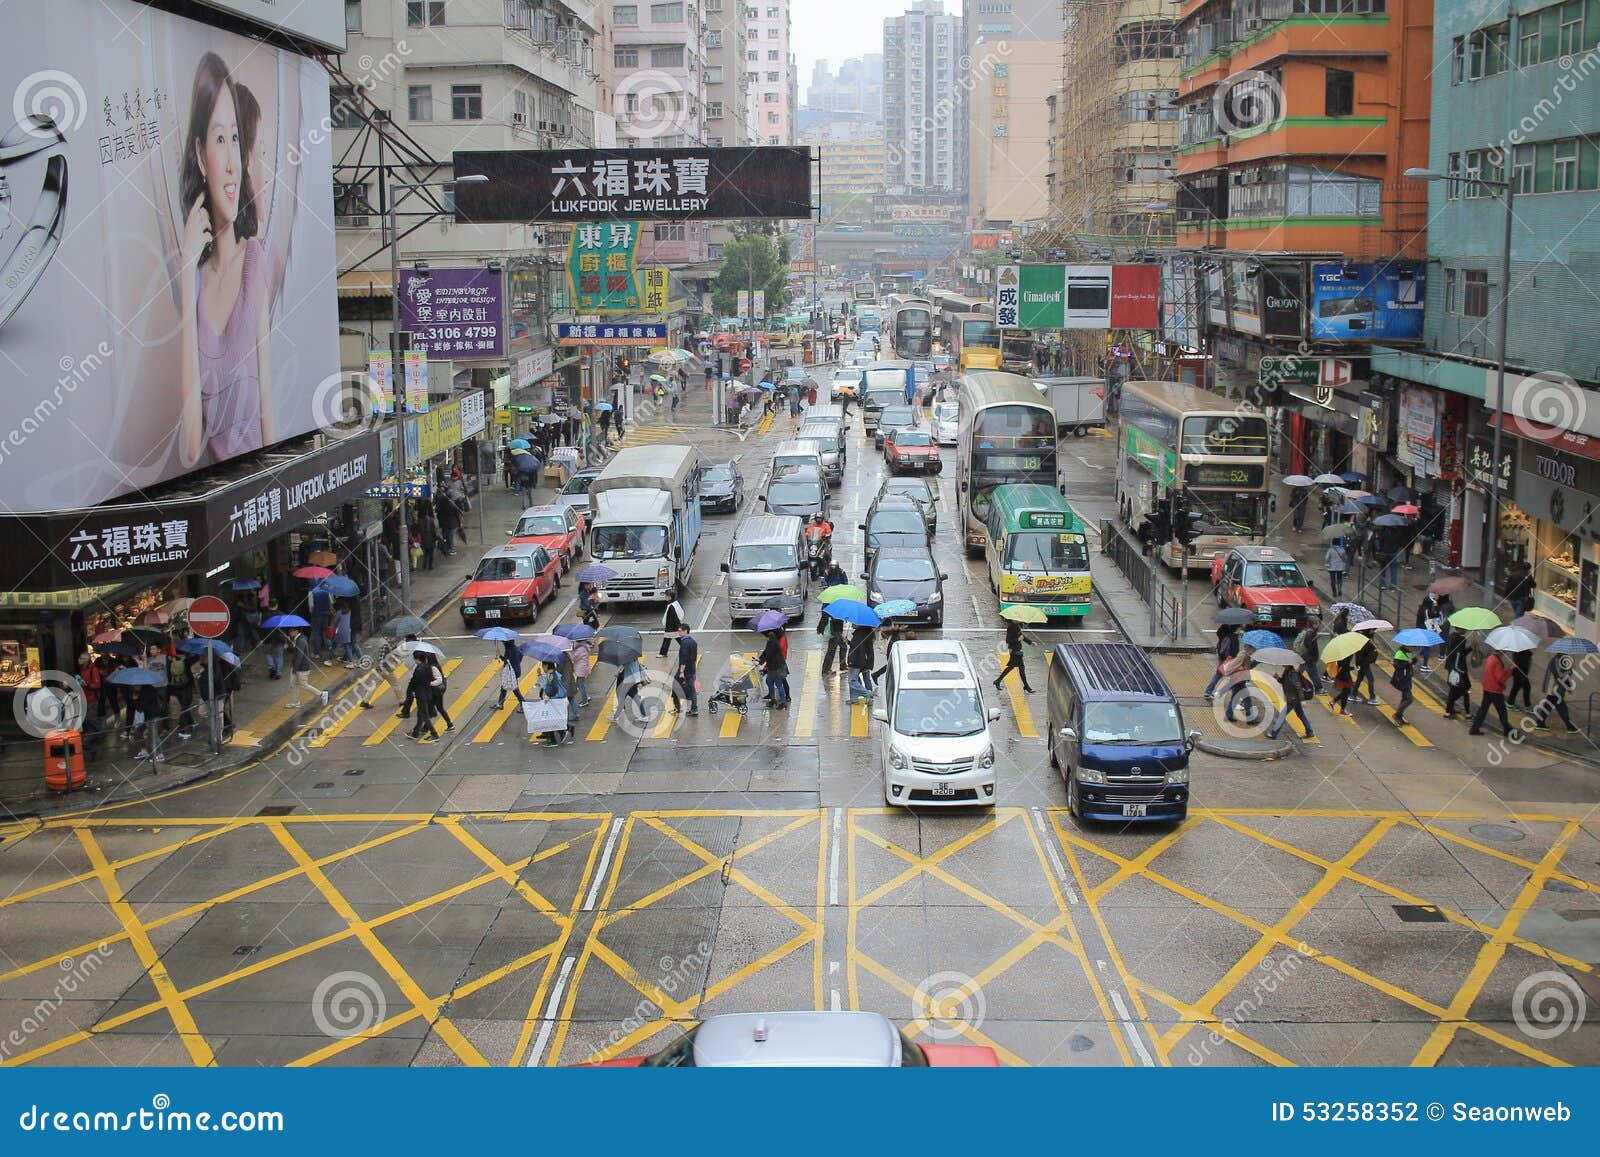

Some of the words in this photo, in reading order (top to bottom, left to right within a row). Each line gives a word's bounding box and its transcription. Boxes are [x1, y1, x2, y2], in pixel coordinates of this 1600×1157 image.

[551, 158, 710, 197] 六福珠寶
[551, 200, 618, 213] LUKFOOK
[623, 198, 710, 213] JEWELLERY
[577, 223, 632, 249] 東昇
[647, 270, 664, 308] 牆紙
[1320, 274, 1341, 282] TGC
[435, 287, 489, 296] EDINBURGH
[1023, 290, 1060, 303] Cimatech
[436, 308, 487, 321] 室內設計
[998, 288, 1017, 326] 成發
[429, 328, 461, 339] 3106
[465, 327, 497, 338] 4799
[286, 473, 326, 511] LUKFOOK
[326, 453, 368, 492] JEWELLERY
[1536, 455, 1576, 487] TUDOR
[229, 487, 282, 543] 六福珠寶
[69, 520, 188, 560] 六福珠寶
[71, 557, 122, 573] LUKFOOK
[126, 548, 190, 566] JEWELLERY
